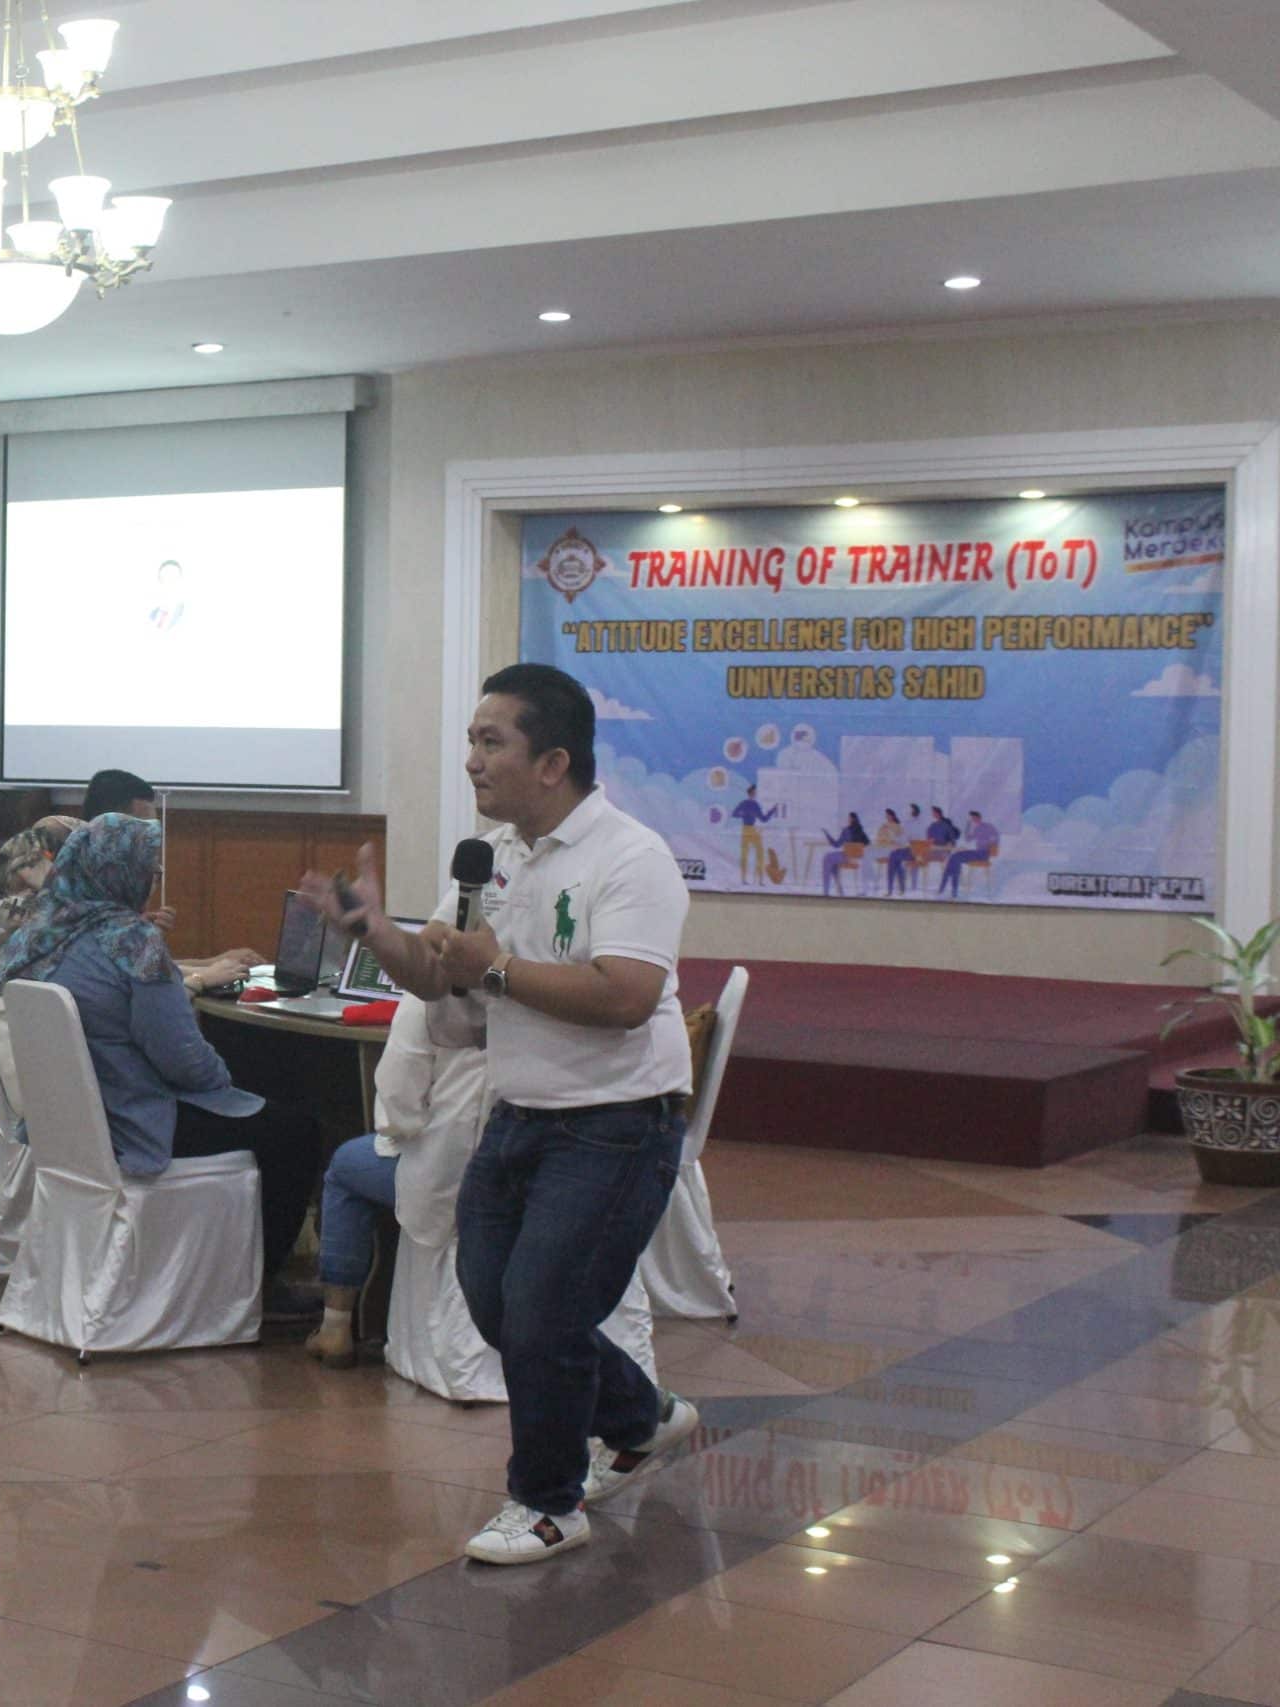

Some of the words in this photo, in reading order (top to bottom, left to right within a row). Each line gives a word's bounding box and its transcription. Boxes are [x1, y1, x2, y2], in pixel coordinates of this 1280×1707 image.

[1124, 535, 1225, 560] Merdek
[628, 547, 785, 593] TRAINING
[796, 545, 837, 586] OF
[847, 541, 994, 584] TRAINER
[1005, 539, 1098, 590] (ToT)
[693, 618, 847, 651] EXCELLENCE
[852, 617, 905, 651] FOR
[911, 616, 977, 651] HIGH
[726, 665, 895, 699] UNIVERSITAS
[903, 665, 985, 699] SAHID
